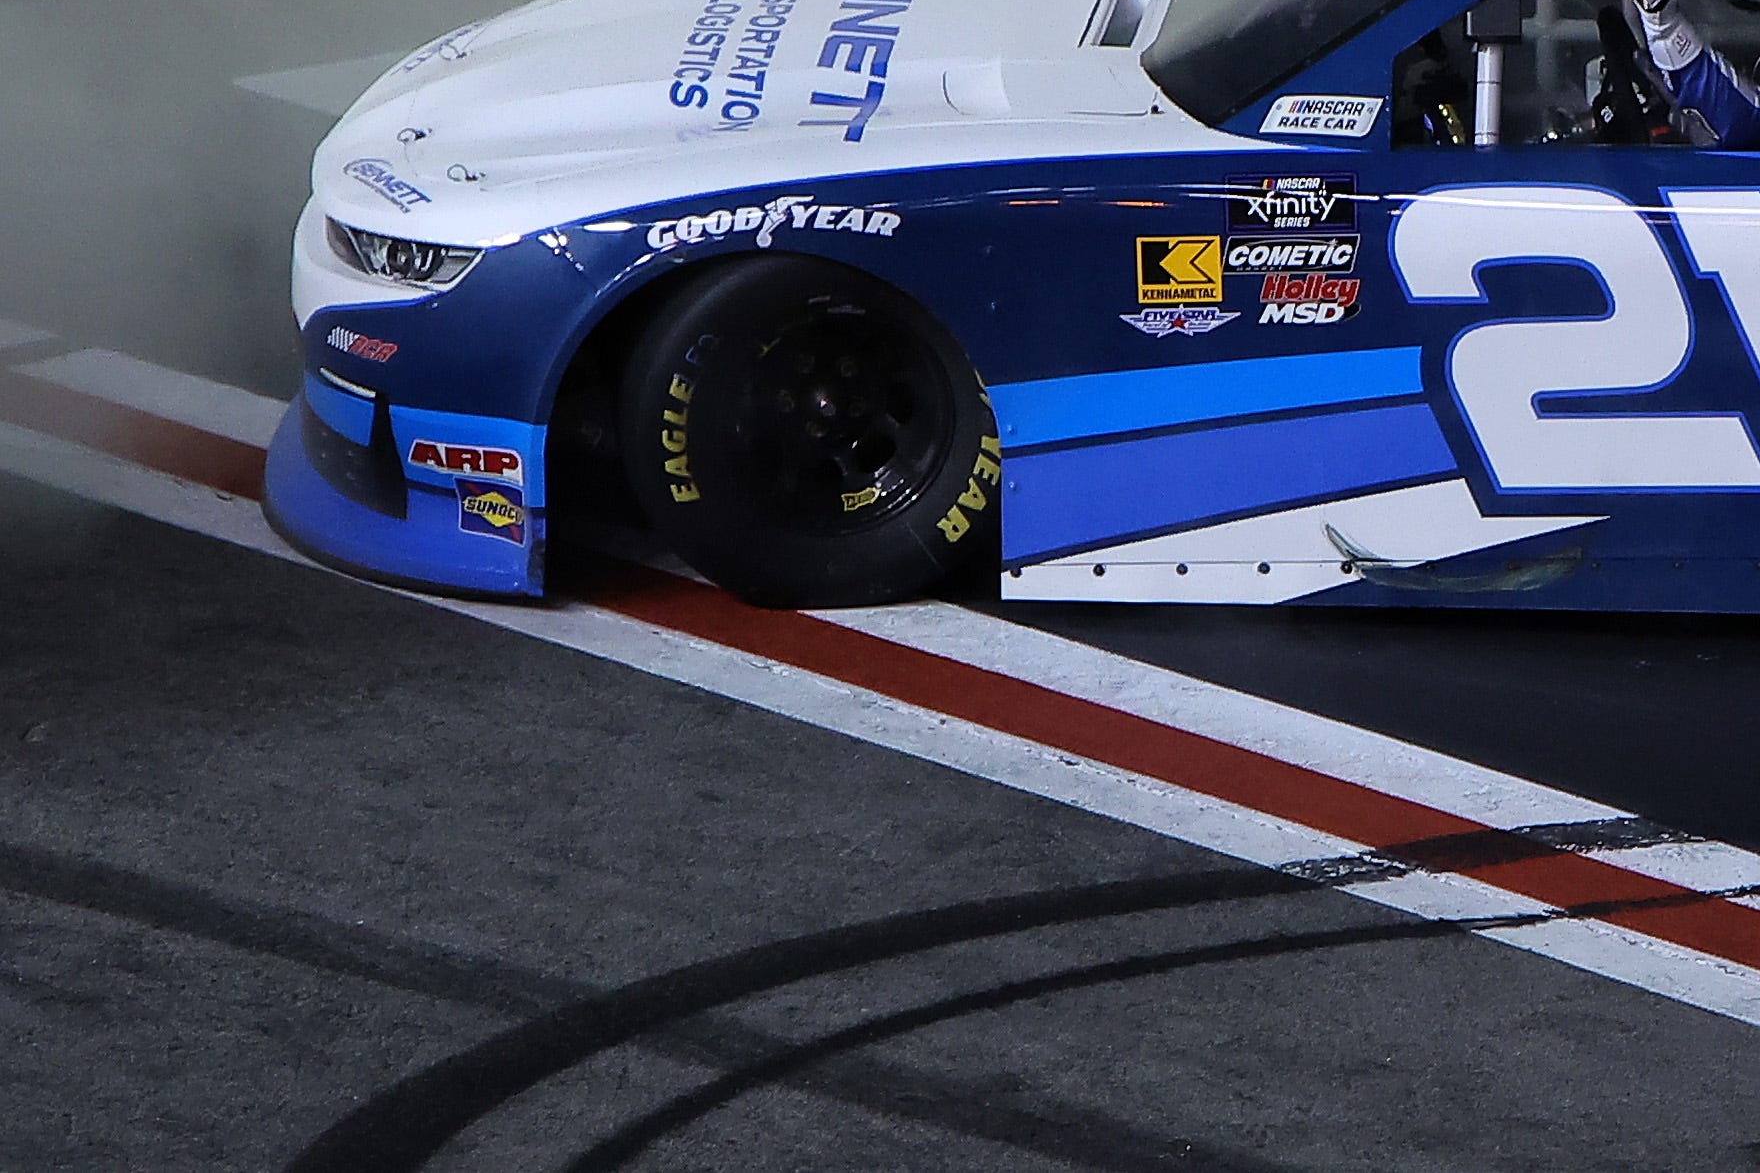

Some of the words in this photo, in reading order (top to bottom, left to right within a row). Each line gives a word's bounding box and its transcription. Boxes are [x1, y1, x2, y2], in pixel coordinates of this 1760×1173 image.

[1302, 99, 1366, 116] NASCAR
[1278, 116, 1321, 129] RACE
[1323, 118, 1358, 131] CAR
[1275, 178, 1321, 189] NASCAR
[1247, 190, 1336, 222] xfinity
[647, 202, 901, 248] GOODYEAR
[1273, 216, 1311, 228] SERIES
[1228, 245, 1354, 267] COMETIC
[1142, 288, 1217, 301] KENNAMETAL
[1260, 273, 1360, 308] Holley
[1258, 302, 1345, 324] MSD
[661, 373, 701, 503] EAGLE
[409, 441, 519, 475] ARP
